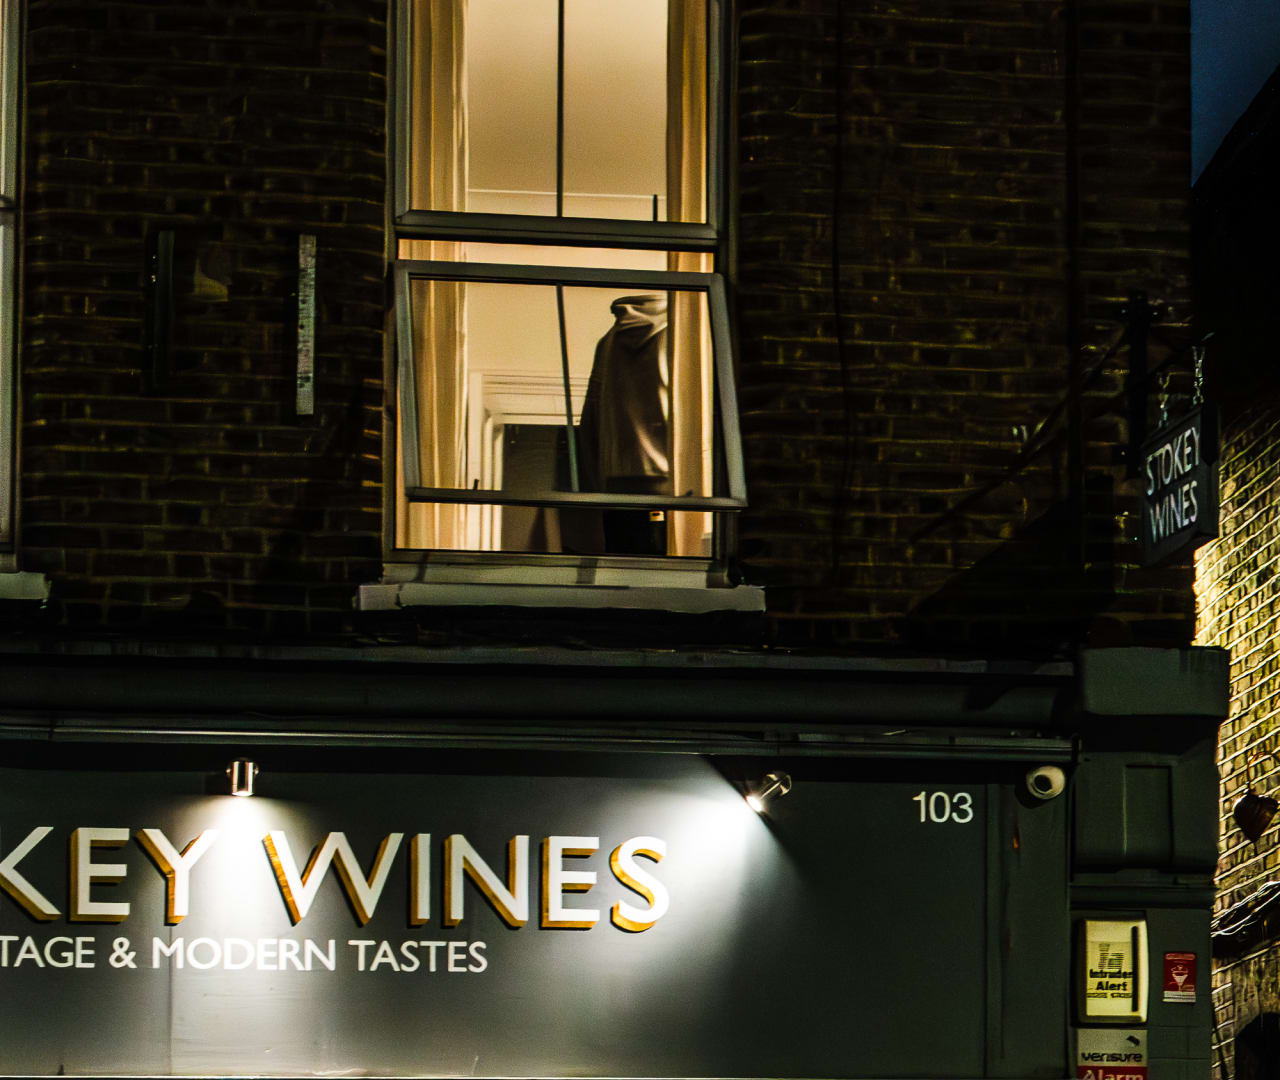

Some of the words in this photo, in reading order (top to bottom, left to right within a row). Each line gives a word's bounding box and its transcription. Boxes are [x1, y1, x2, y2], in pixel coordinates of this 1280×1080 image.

[1147, 427, 1200, 496] STOKEY
[1151, 481, 1198, 543] WINES
[912, 791, 974, 824] 103
[0, 826, 219, 926] KEY
[262, 830, 671, 933] WINES
[0, 935, 96, 969] TAGE
[109, 936, 137, 969] &
[152, 937, 336, 971] MODERN
[348, 939, 488, 973] TASTES
[1096, 981, 1128, 992] Alert
